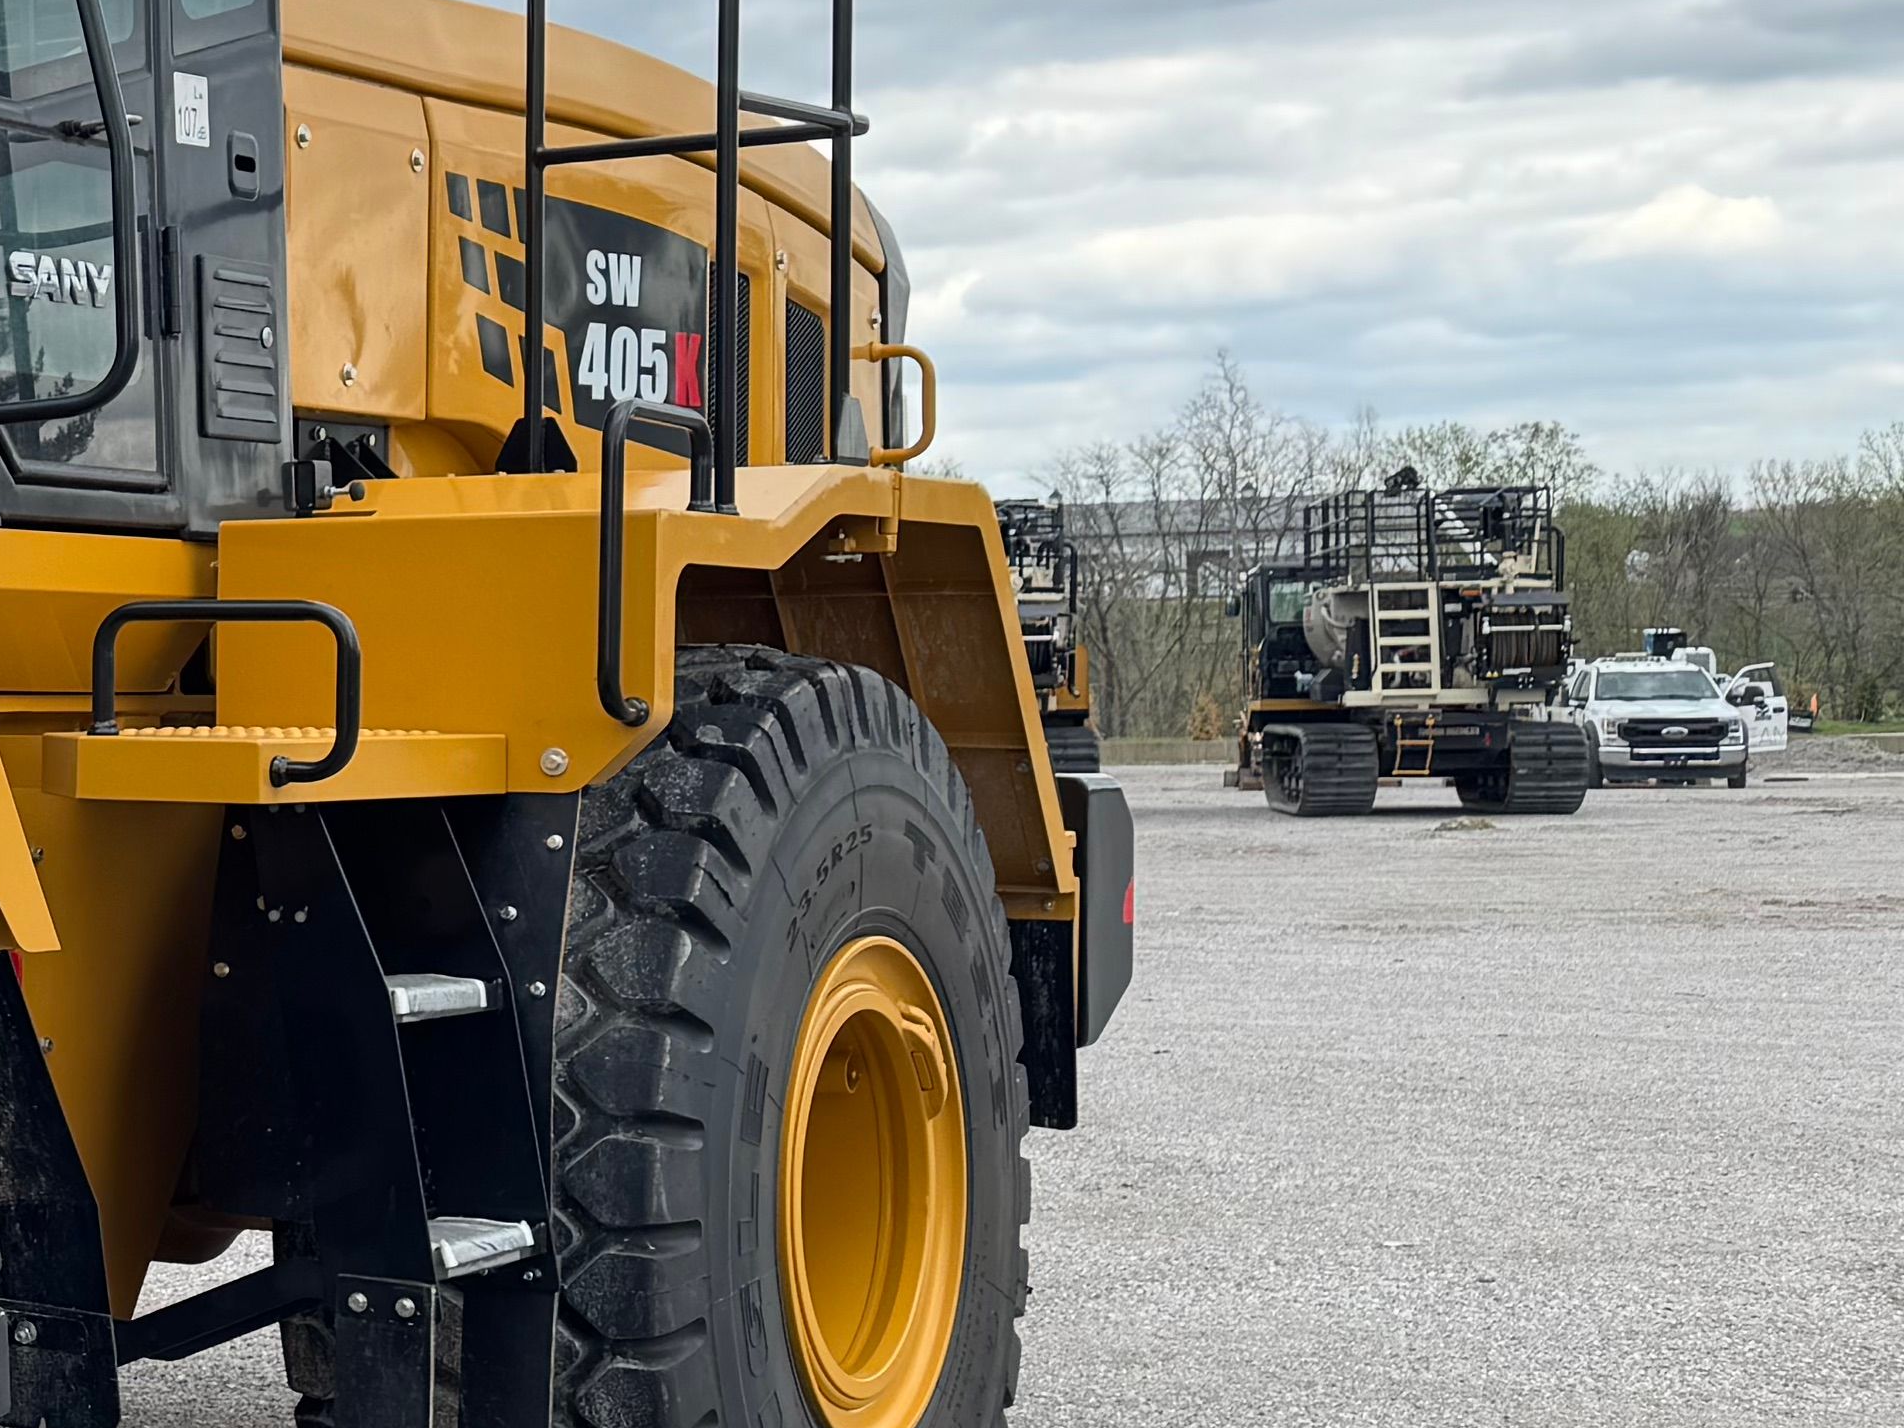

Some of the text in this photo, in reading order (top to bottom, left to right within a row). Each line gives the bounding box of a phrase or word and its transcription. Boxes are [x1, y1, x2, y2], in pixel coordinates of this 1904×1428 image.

[178, 104, 197, 139] 107
[8, 250, 113, 309] SANY
[585, 249, 642, 307] SW
